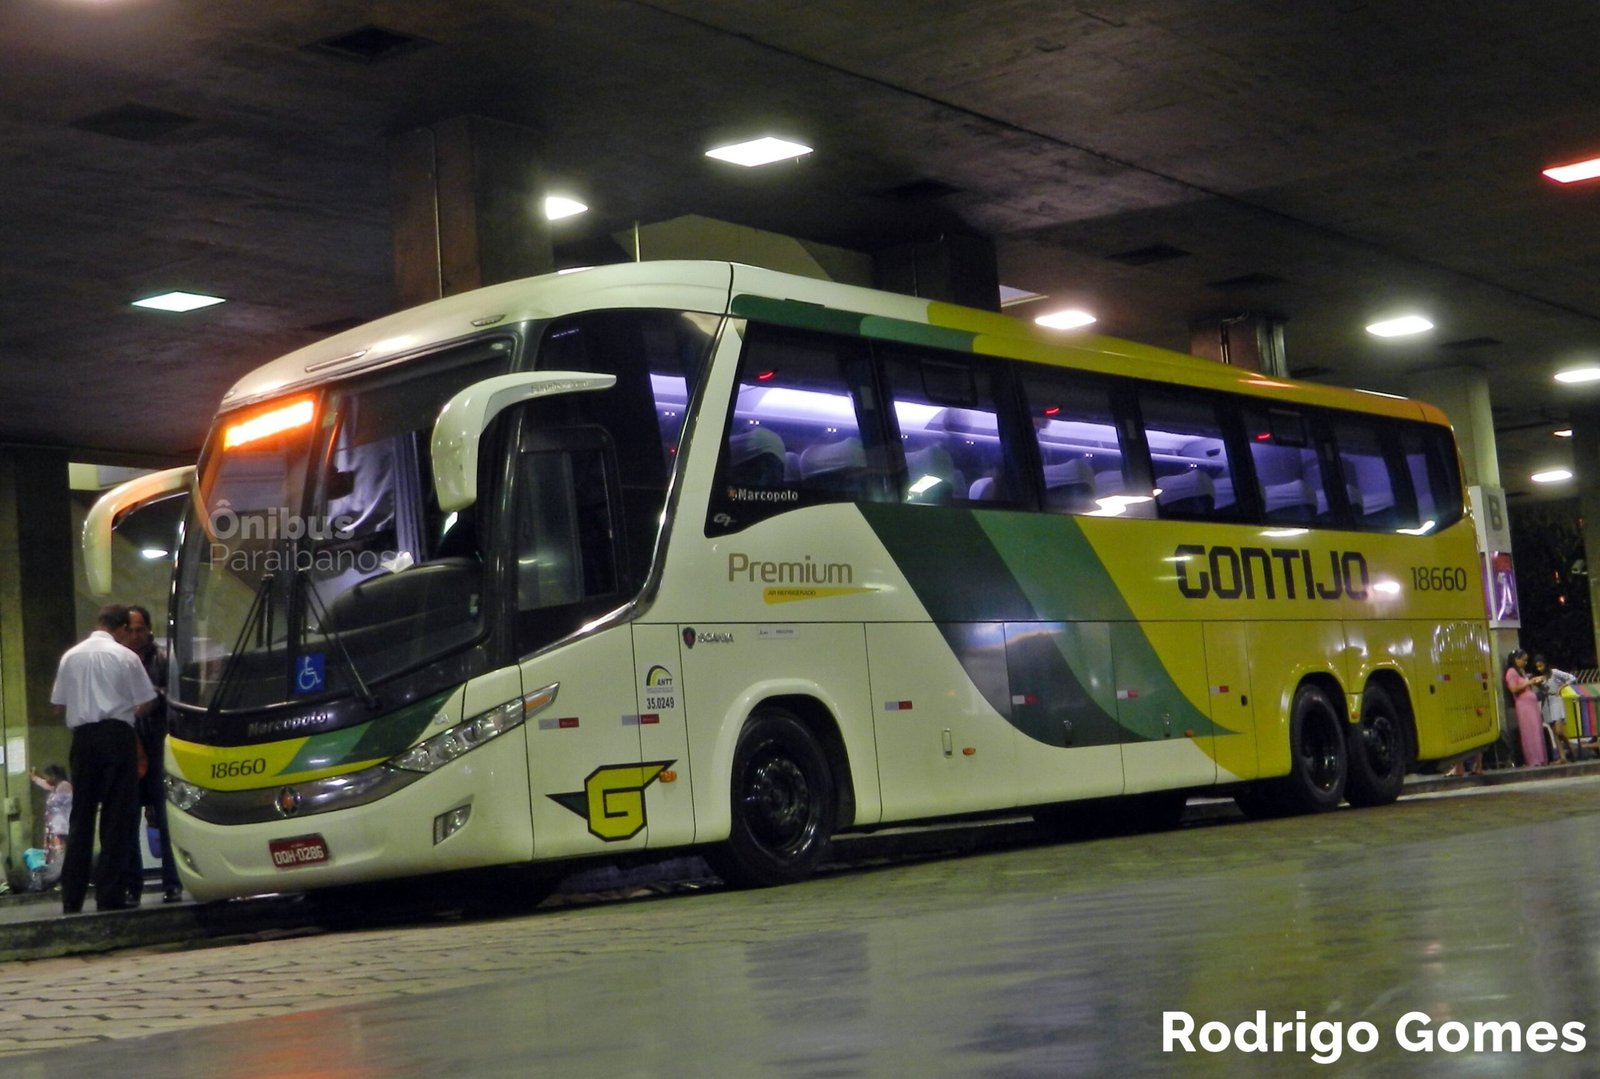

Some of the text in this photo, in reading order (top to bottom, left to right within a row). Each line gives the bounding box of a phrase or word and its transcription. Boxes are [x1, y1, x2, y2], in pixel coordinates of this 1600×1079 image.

[738, 488, 799, 503] Marcopolo
[1488, 494, 1503, 531] B
[728, 552, 853, 584] Premium
[1175, 544, 1370, 600] GONTIJO
[1410, 566, 1467, 592] 18660
[657, 678, 673, 686] ANTT
[646, 696, 675, 710] 35.0249
[248, 711, 328, 736] Marcopolo
[211, 757, 266, 779] 18660
